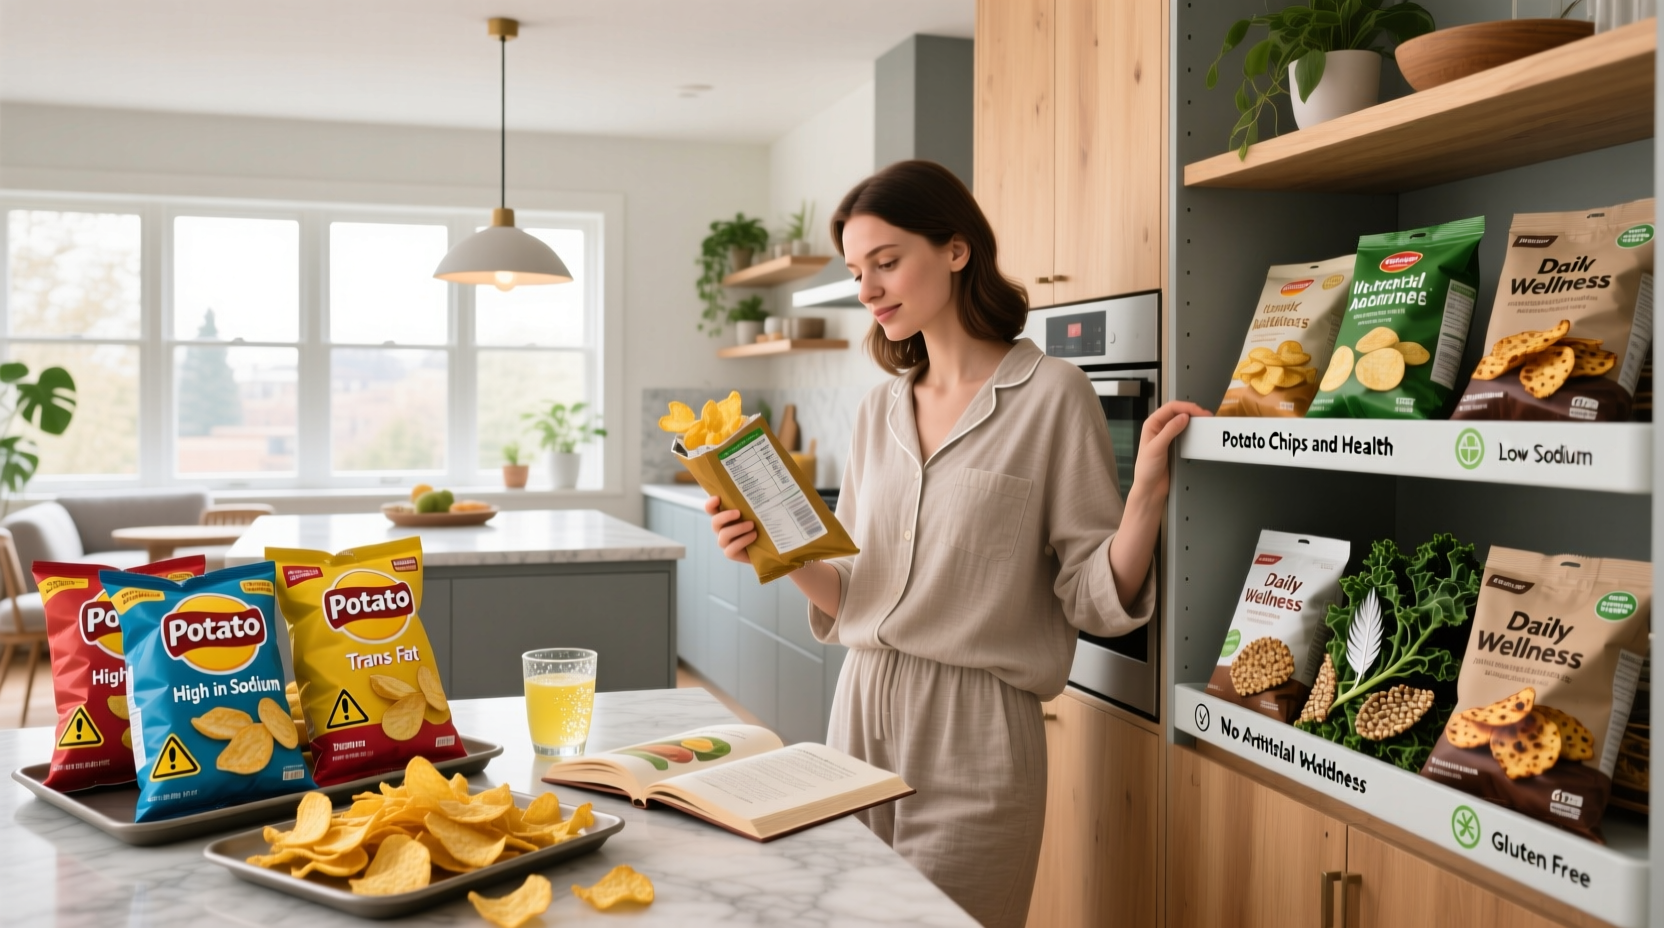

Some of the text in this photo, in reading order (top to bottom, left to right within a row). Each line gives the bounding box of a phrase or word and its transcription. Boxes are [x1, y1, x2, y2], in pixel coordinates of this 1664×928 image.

[1511, 275, 1612, 295] Wellness
[1222, 430, 1394, 457] Potato Chips and Health
[1498, 442, 1593, 466] Low Sodium
[1264, 572, 1304, 595] Daily
[328, 589, 410, 620] Potato
[1244, 588, 1304, 612] Wellness
[168, 615, 261, 647] Potato
[1506, 610, 1575, 645] Daily
[345, 645, 420, 671] Trans Fat
[1477, 630, 1584, 669] Wellness
[173, 676, 281, 705] High in Sodium
[1220, 716, 1239, 740] No
[1491, 831, 1591, 889] Gluten Free
